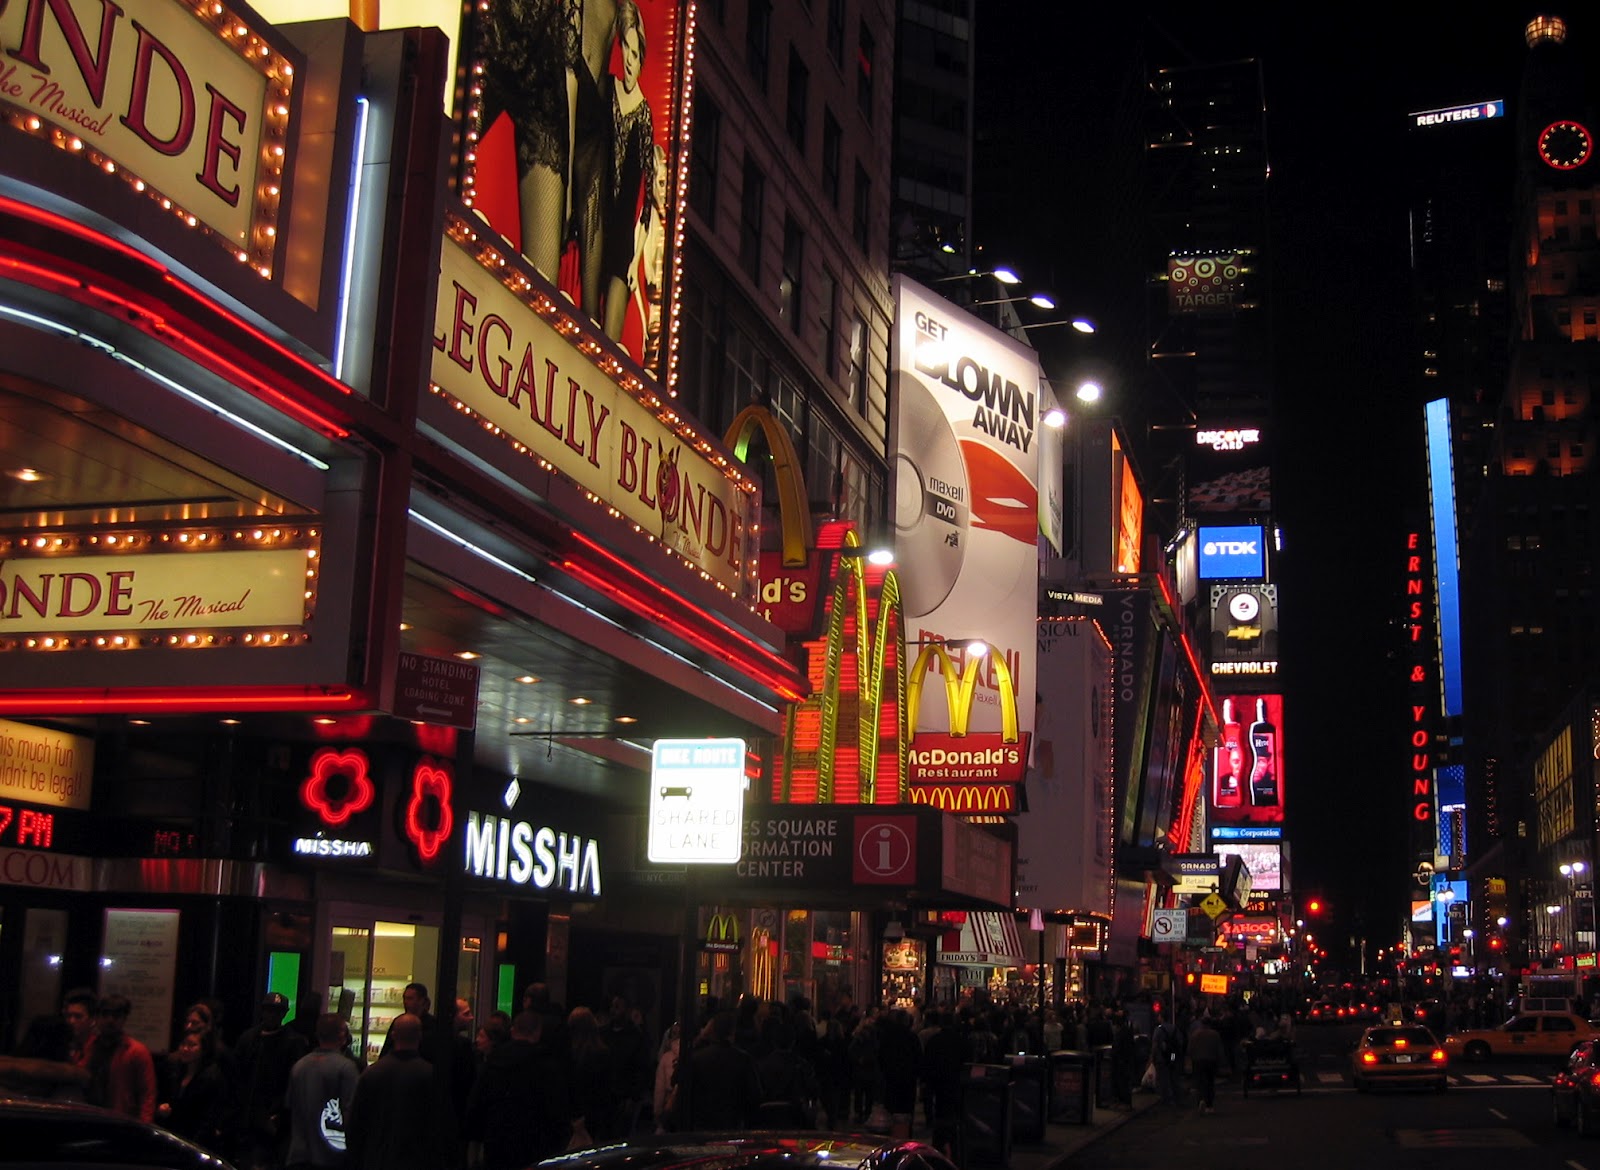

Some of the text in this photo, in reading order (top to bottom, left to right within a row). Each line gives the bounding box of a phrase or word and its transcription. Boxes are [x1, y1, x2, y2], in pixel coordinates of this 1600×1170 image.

[0, 0, 247, 208] NDE
[29, 73, 113, 137] Musical
[1416, 107, 1480, 126] REUTERS
[1176, 292, 1235, 307] TARGET
[914, 311, 948, 341] GET
[433, 279, 610, 470] EGALLY
[972, 404, 1033, 454] AWAY
[1212, 441, 1244, 451] CARD
[929, 476, 964, 503] maxell
[936, 501, 956, 519] DVD
[1219, 541, 1257, 555] TDK
[0, 570, 252, 624] NDE The Musical
[1046, 590, 1104, 606] VISTA MEDIA
[1120, 594, 1135, 702] VORNADO
[401, 655, 474, 680] NO STANDING
[1211, 661, 1279, 675] CHEVROLET
[1407, 533, 1430, 821] ERNST & YOUNG
[421, 676, 451, 690] HOTEL
[404, 687, 466, 706] LOADING ZONE
[17, 737, 51, 765] much
[54, 739, 74, 769] fun
[908, 748, 1020, 765] McDonald's
[30, 763, 46, 792] be
[918, 767, 999, 778] Restaurant
[656, 808, 736, 827] SHARED
[17, 807, 54, 848] PM
[767, 819, 838, 838] SQUARE
[1221, 827, 1280, 839] News Corporation
[295, 837, 371, 856] MISSHA
[669, 832, 721, 850] LANE
[464, 810, 602, 896] MISSHA
[736, 860, 805, 877] CENTER
[1575, 890, 1593, 899] NFL
